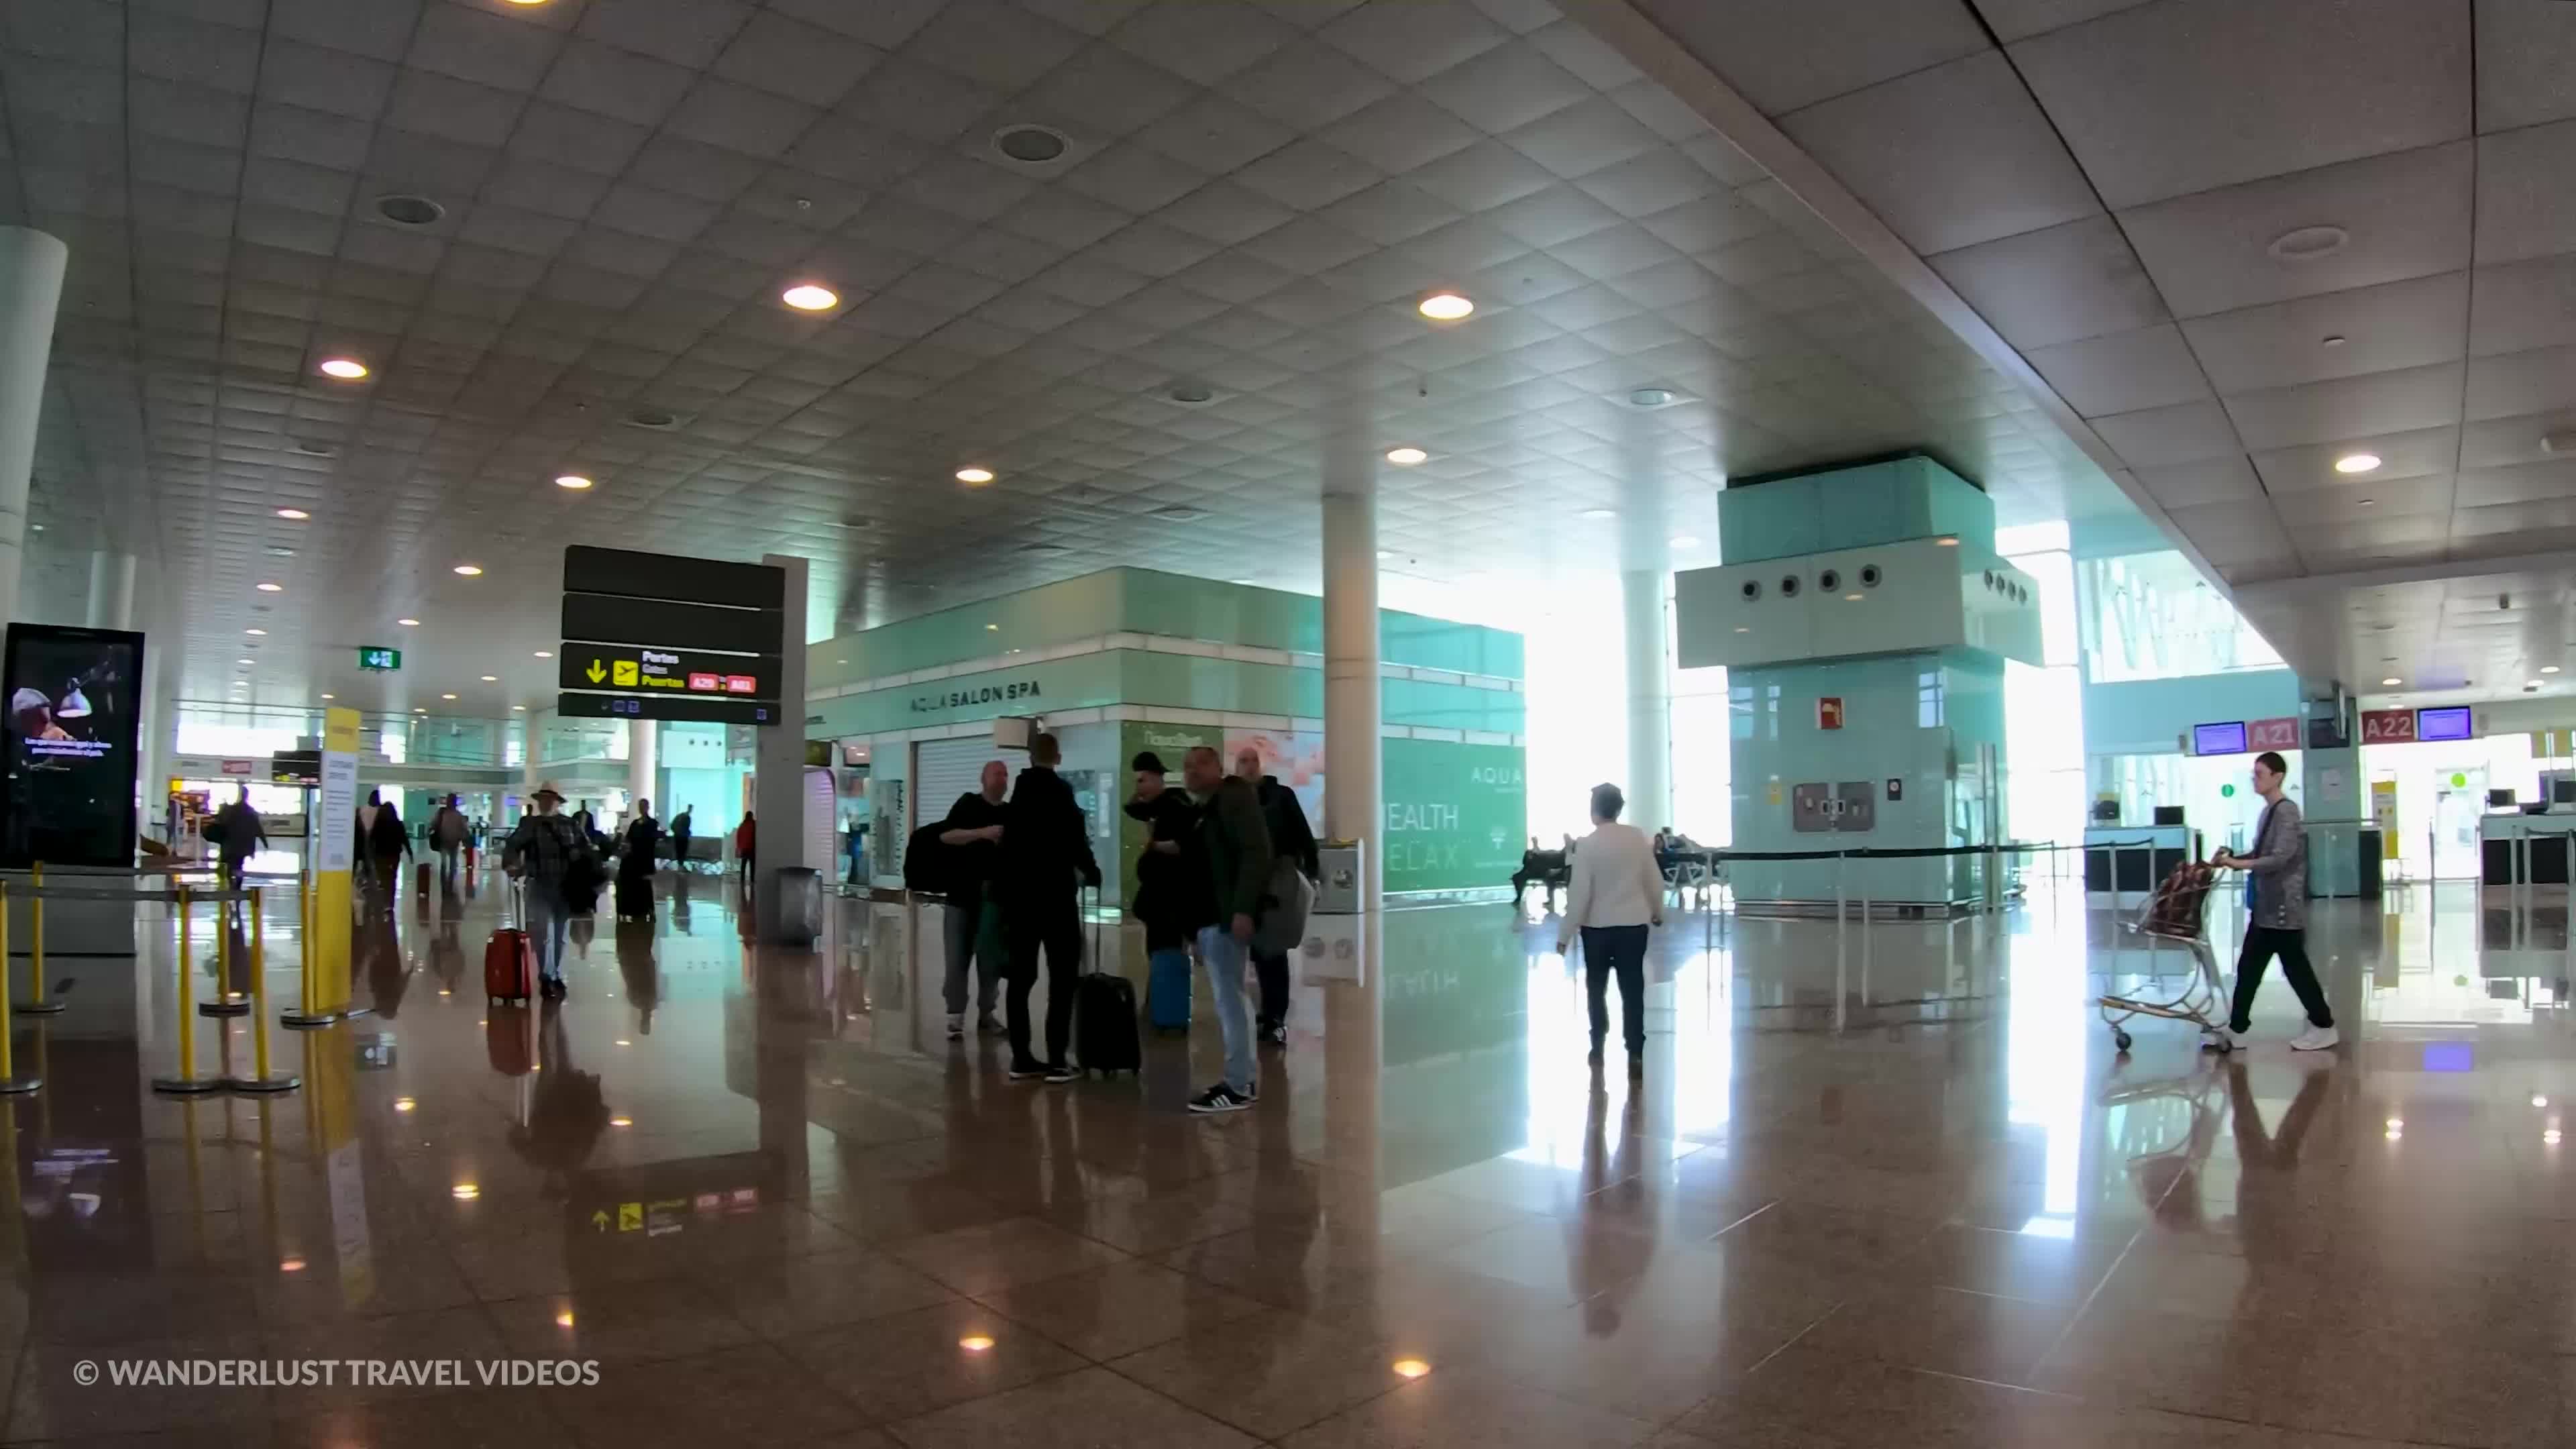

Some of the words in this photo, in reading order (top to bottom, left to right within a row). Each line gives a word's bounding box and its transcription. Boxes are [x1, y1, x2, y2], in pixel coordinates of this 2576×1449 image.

[950, 686, 1003, 707] SALON
[1007, 681, 1040, 700] SPA
[2253, 722, 2295, 744] A21
[2366, 716, 2412, 738] A22
[1471, 767, 1523, 784] AQUA
[1389, 842, 1460, 871] ELAX
